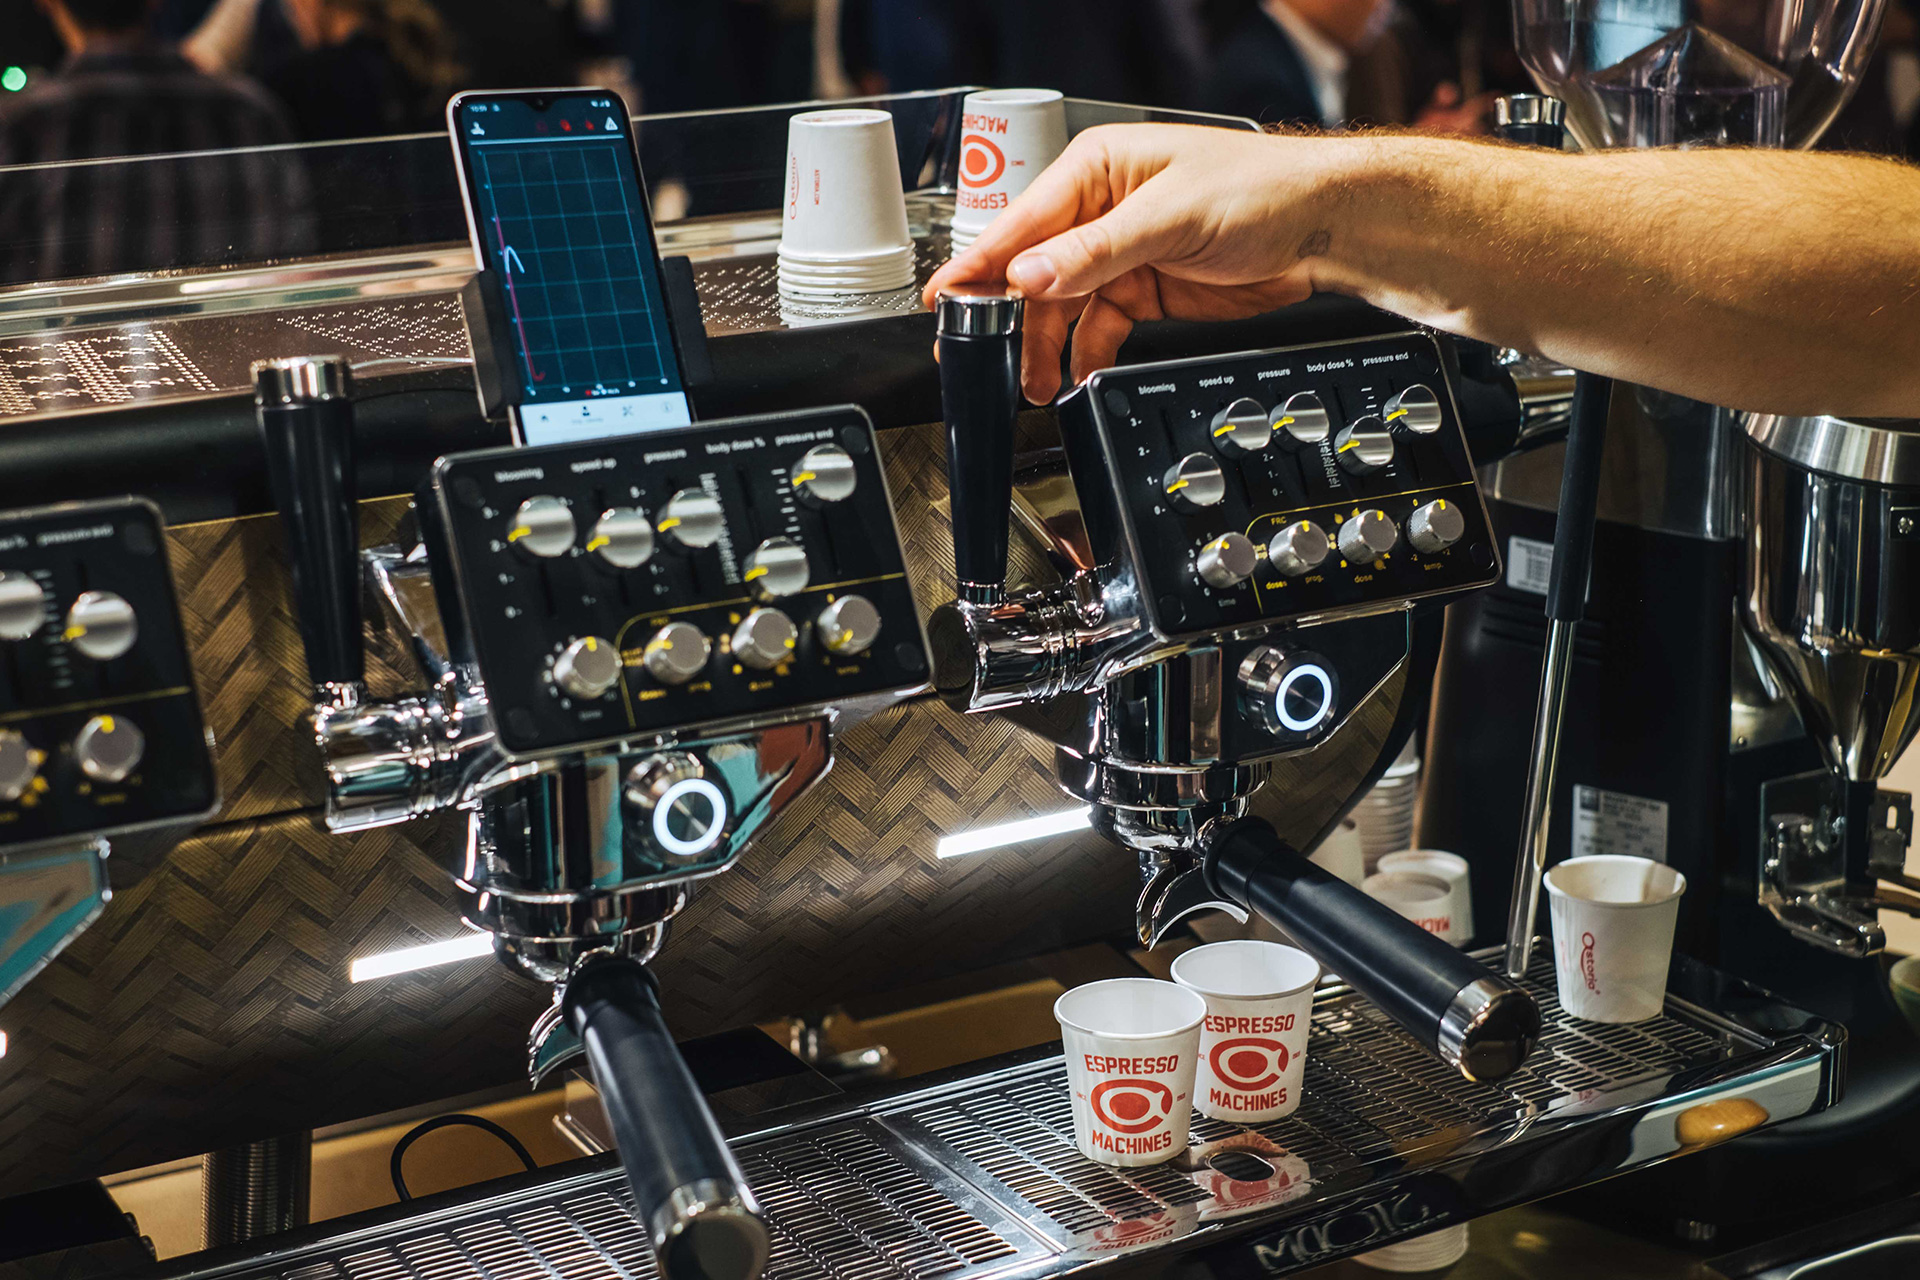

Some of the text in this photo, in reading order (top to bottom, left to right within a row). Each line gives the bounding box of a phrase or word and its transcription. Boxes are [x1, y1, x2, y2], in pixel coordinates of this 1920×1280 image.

[1306, 358, 1354, 374] body dose %
[1362, 352, 1409, 367] pressure end
[1199, 376, 1235, 388] speed up
[1257, 368, 1291, 381] pressure
[1138, 383, 1176, 395] blooming
[775, 428, 834, 446] pressure end
[705, 442, 730, 454] body
[731, 439, 754, 450] dose
[570, 457, 617, 473] speed up
[644, 449, 687, 465] pressure
[494, 467, 544, 483] blooming
[1205, 1014, 1295, 1034] ESPRESSO
[1084, 1054, 1179, 1075] ESPRESSO
[1209, 1087, 1287, 1111] MACHINES
[1092, 1129, 1171, 1154] MACHINES
